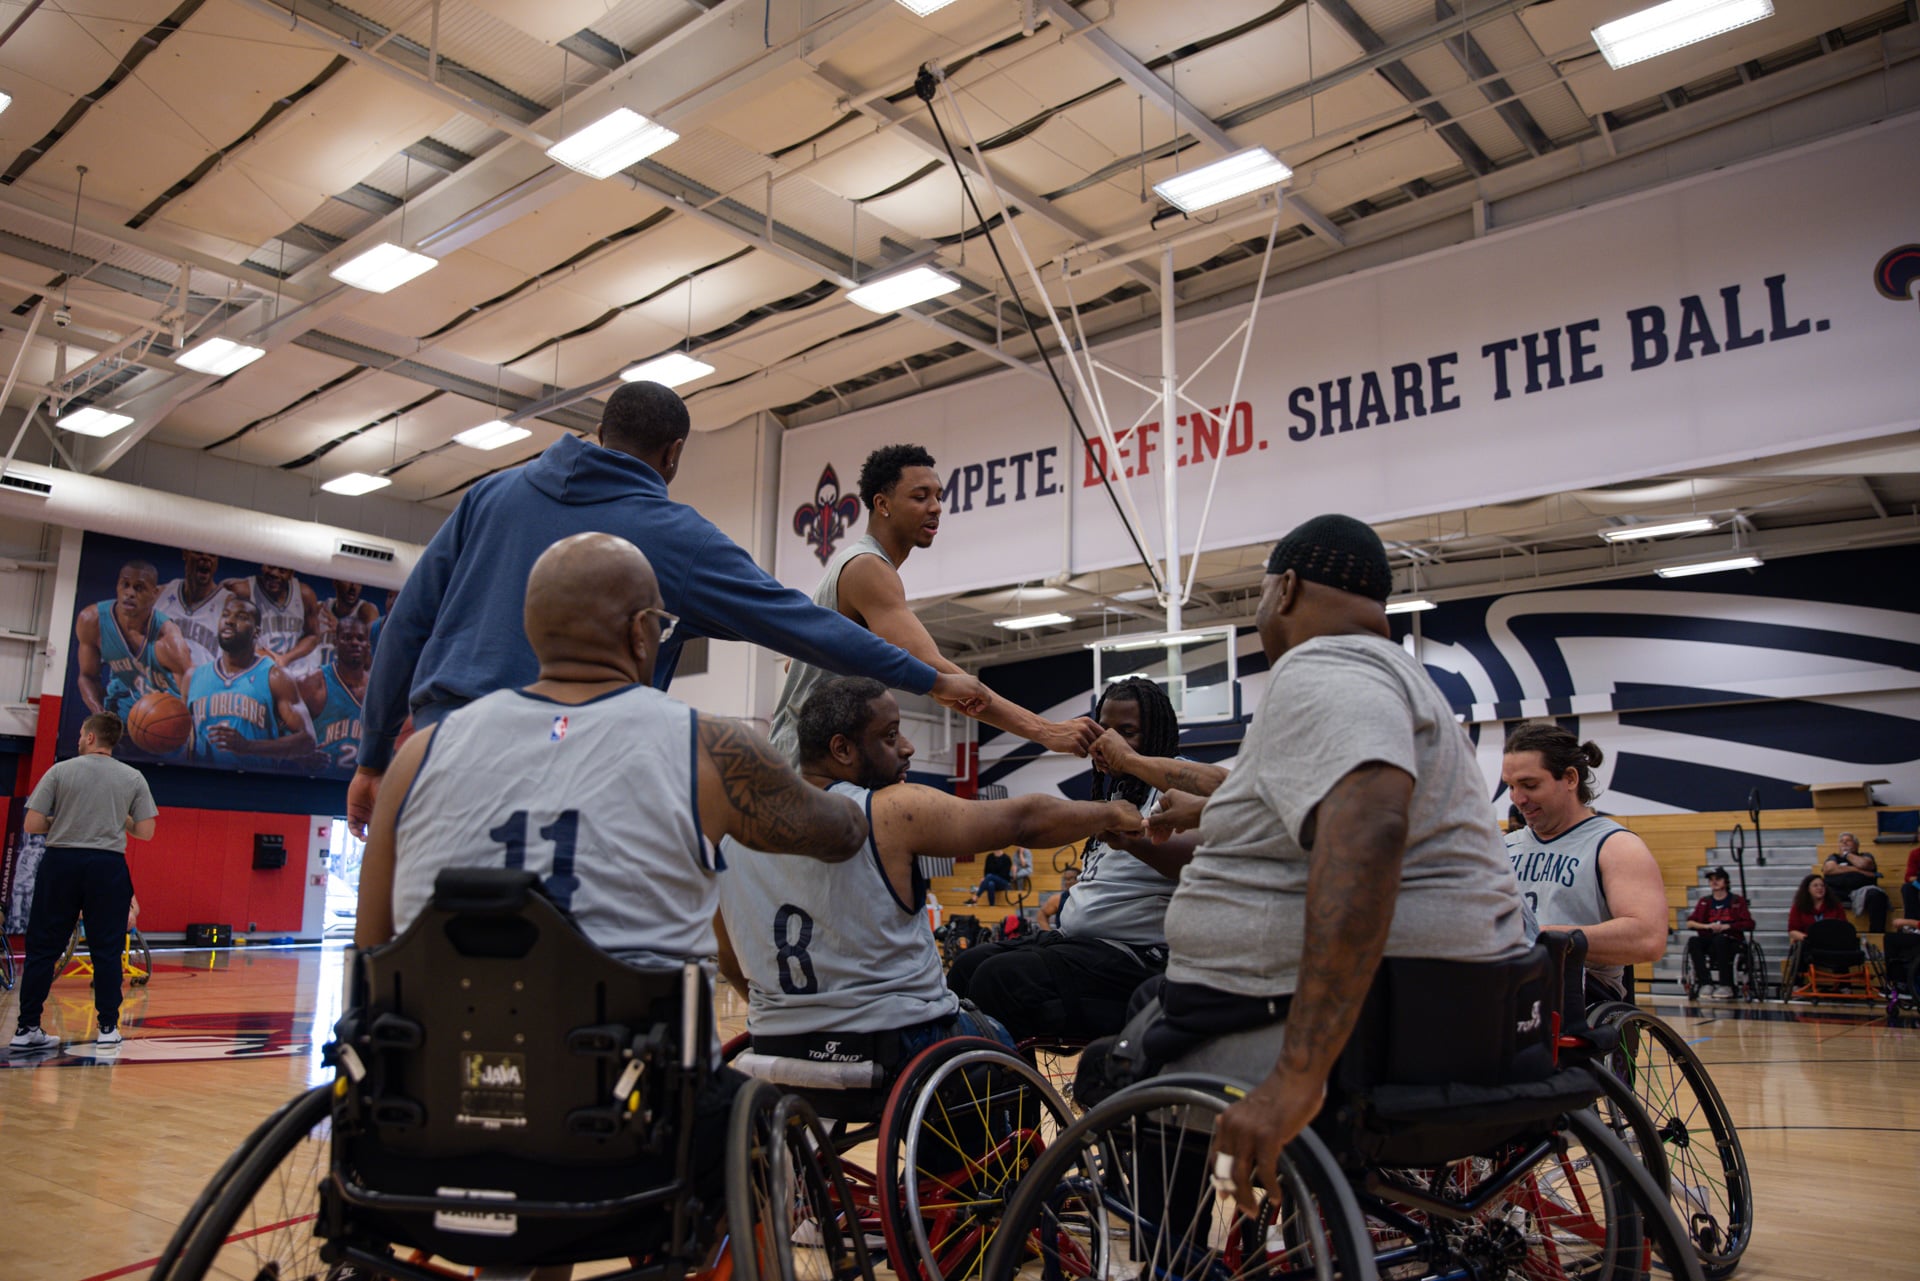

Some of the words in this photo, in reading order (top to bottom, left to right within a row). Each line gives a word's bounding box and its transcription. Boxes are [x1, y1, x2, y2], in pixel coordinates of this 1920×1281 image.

[941, 446, 1064, 514] MPETE.
[1083, 400, 1268, 488] DEFEND.
[1288, 352, 1461, 442] SHARE
[1481, 318, 1604, 401] THE
[1626, 273, 1831, 372] BALL.
[210, 691, 266, 729] ORLEANS
[326, 719, 350, 744] NEW
[489, 809, 580, 911] 11
[1510, 852, 1579, 888] LICANS
[773, 903, 818, 995] 8
[809, 1049, 830, 1060] TOP
[482, 1064, 521, 1086] JAVA
